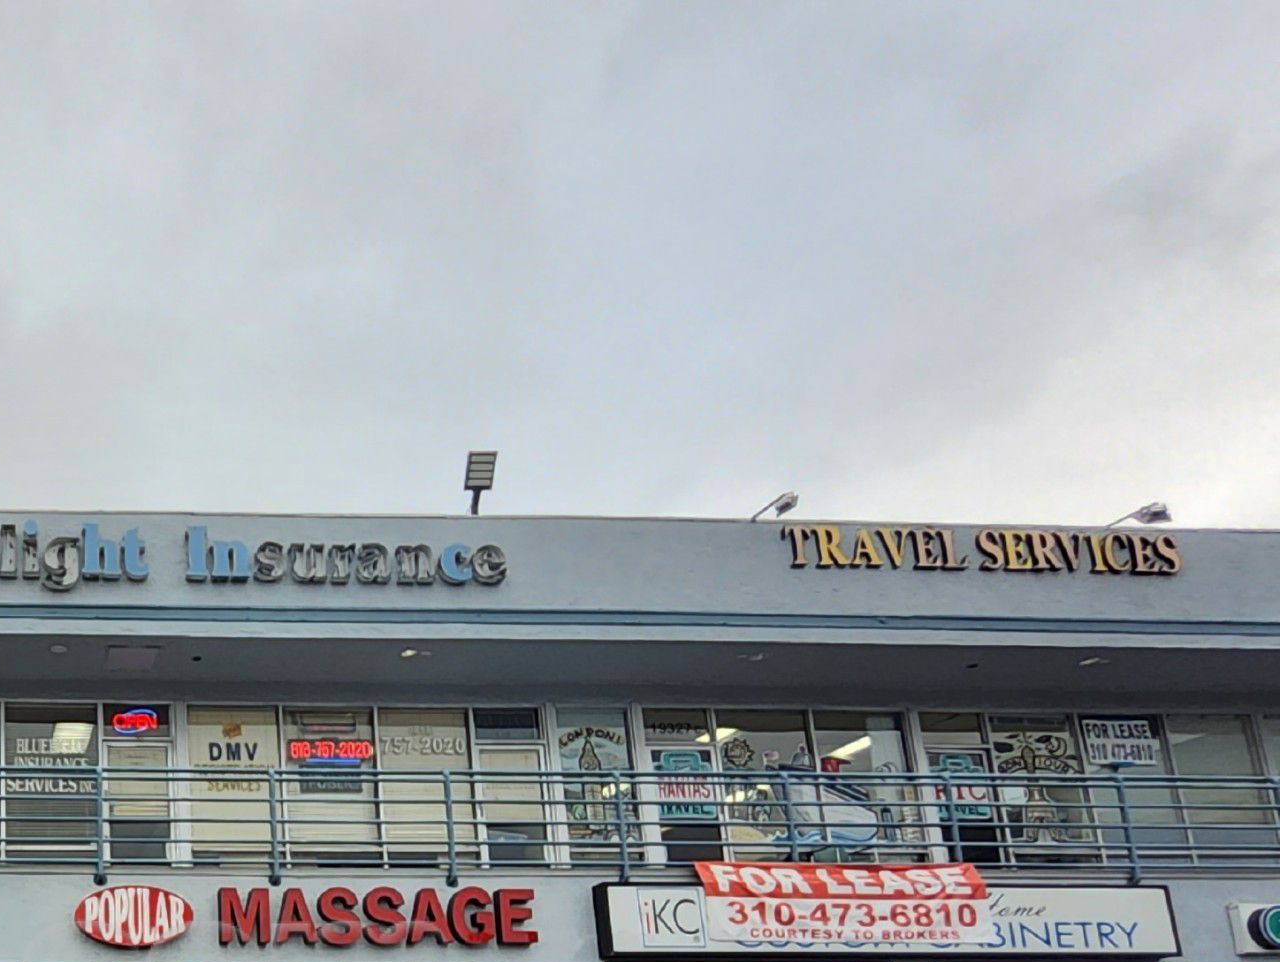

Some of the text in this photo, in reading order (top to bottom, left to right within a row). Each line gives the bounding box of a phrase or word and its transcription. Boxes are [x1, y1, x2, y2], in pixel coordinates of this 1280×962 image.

[185, 525, 508, 586] Insurance
[781, 525, 1183, 576] TRAVEL SERVICES
[113, 713, 158, 730] OPEN
[1085, 723, 1149, 740] FOR LEASE
[208, 742, 258, 761] DMV
[6, 778, 77, 793] SERVICES
[709, 864, 973, 895] FOR LEASE
[84, 886, 186, 943] POPULAR
[219, 886, 539, 946] MASSAGE
[644, 898, 701, 935] iKC
[727, 901, 977, 928] 310-473-6810
[750, 928, 961, 941] COURTESY TO BROKERS
